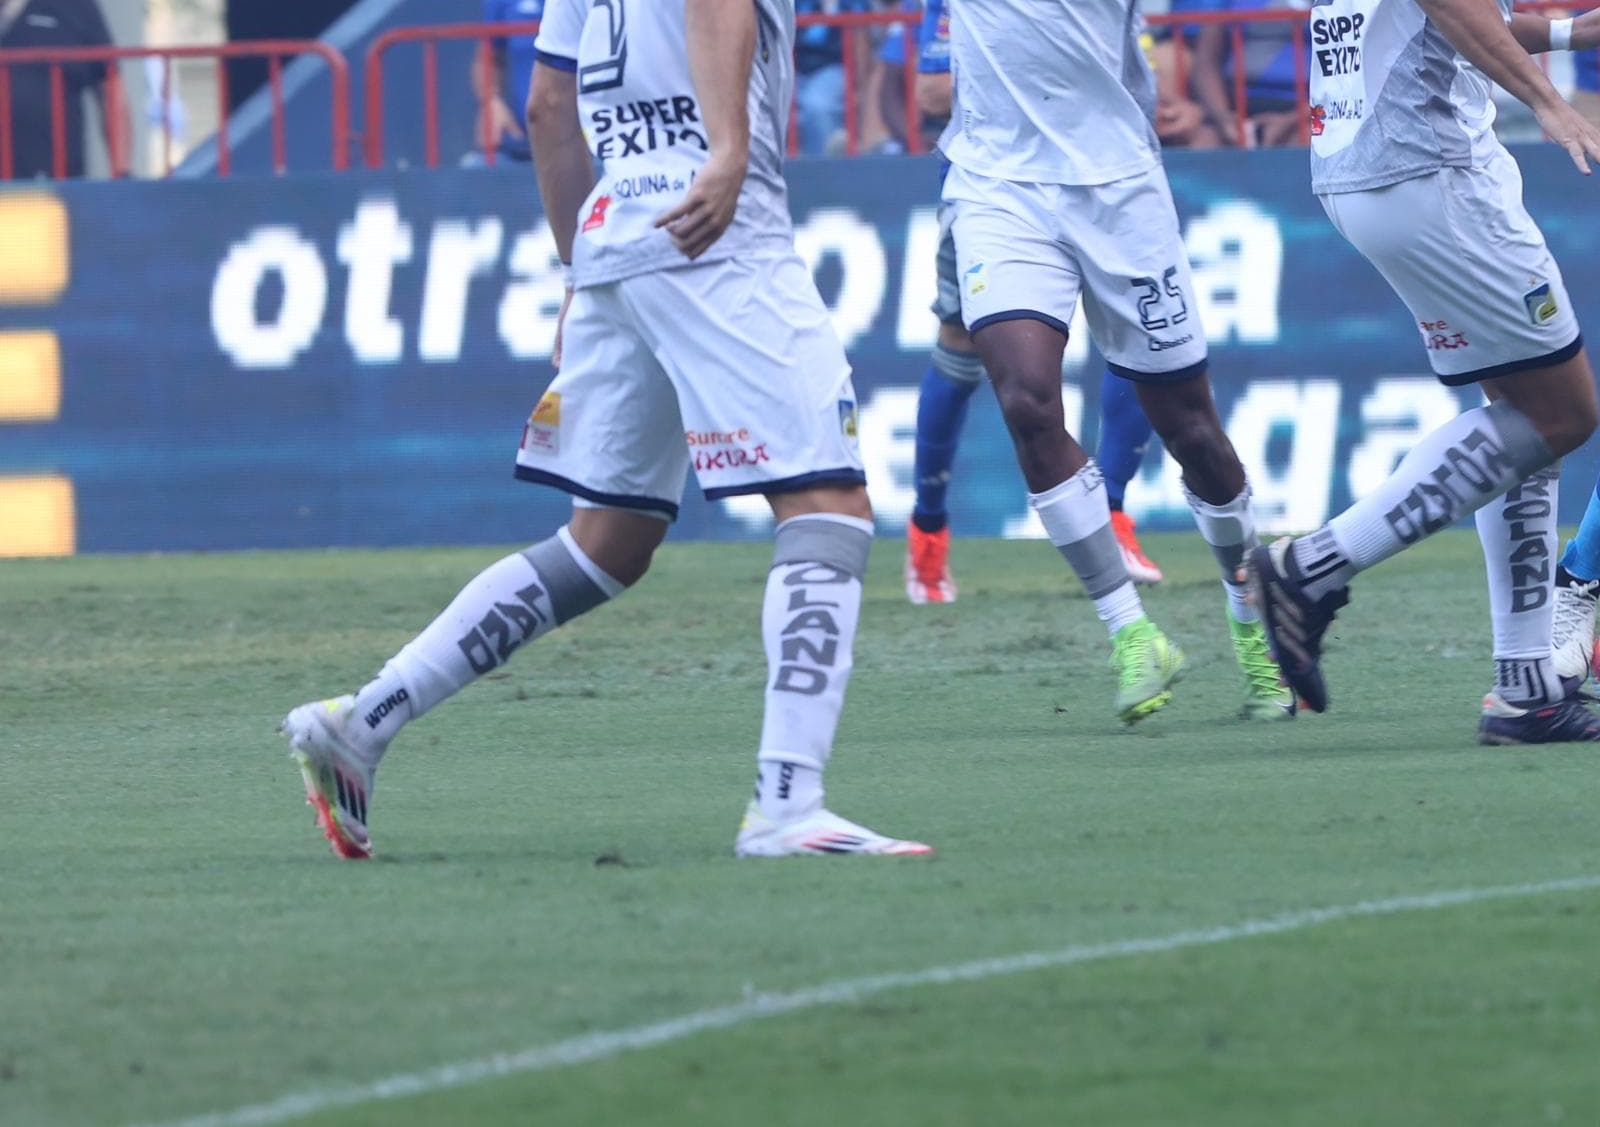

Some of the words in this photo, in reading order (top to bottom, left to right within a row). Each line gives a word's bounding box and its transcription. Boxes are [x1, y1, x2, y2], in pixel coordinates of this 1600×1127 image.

[591, 95, 699, 134] SUPER
[209, 197, 568, 369] otra
[1130, 265, 1187, 331] 25
